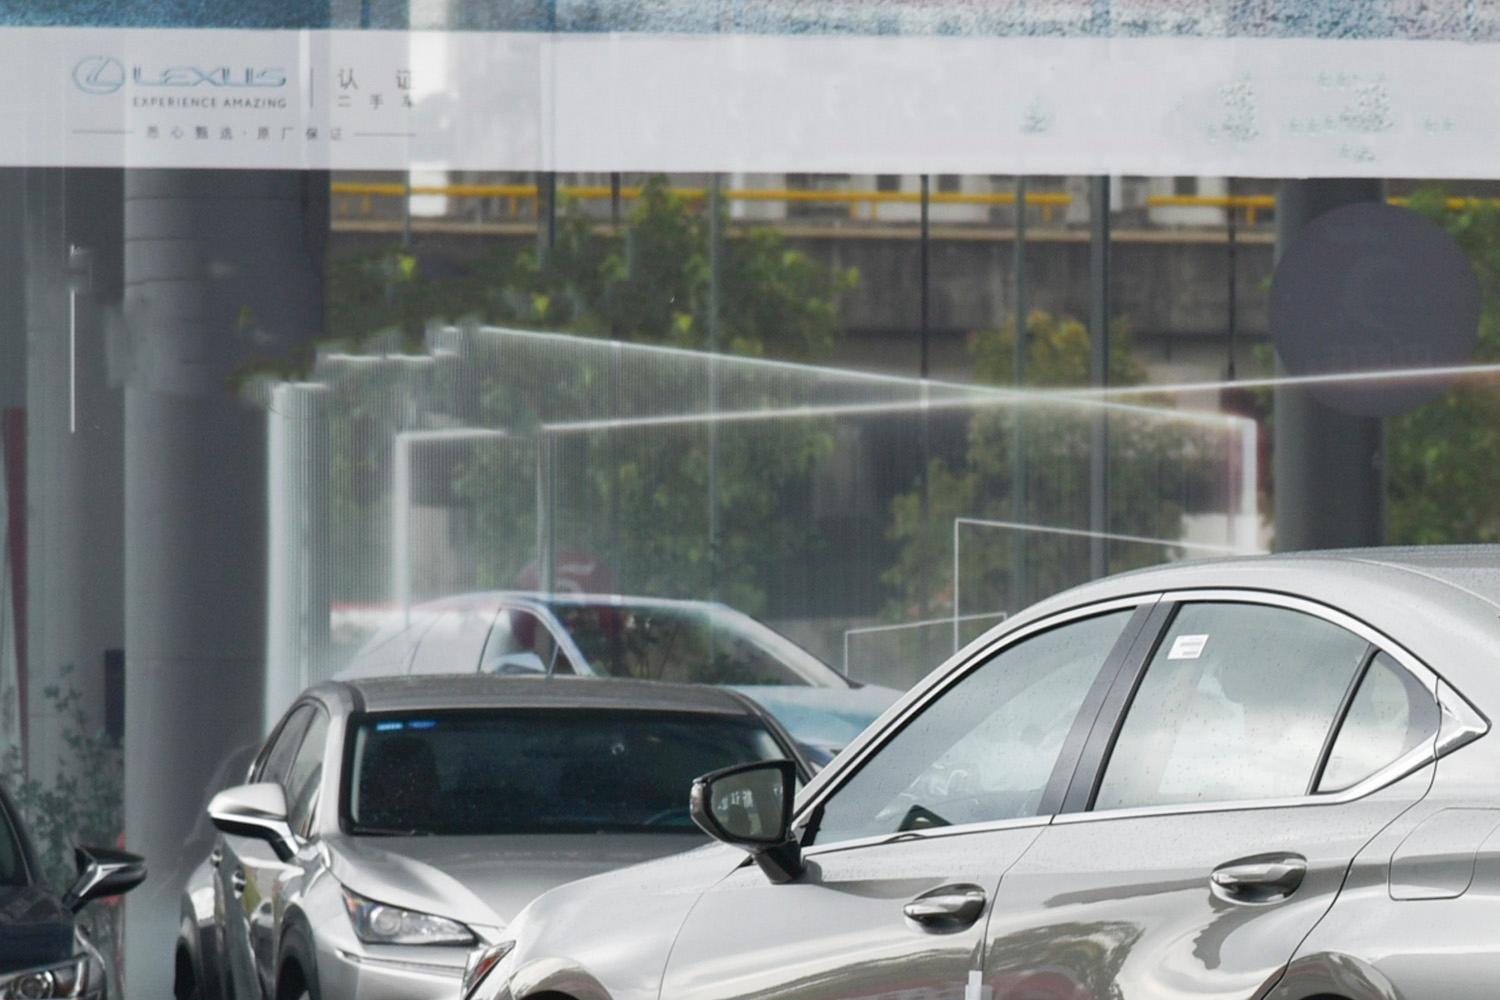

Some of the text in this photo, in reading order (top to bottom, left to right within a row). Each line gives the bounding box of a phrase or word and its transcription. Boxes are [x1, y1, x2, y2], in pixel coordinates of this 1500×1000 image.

[132, 66, 287, 87] LEXUS
[132, 97, 287, 109] EXPERIENCE AMAZING
